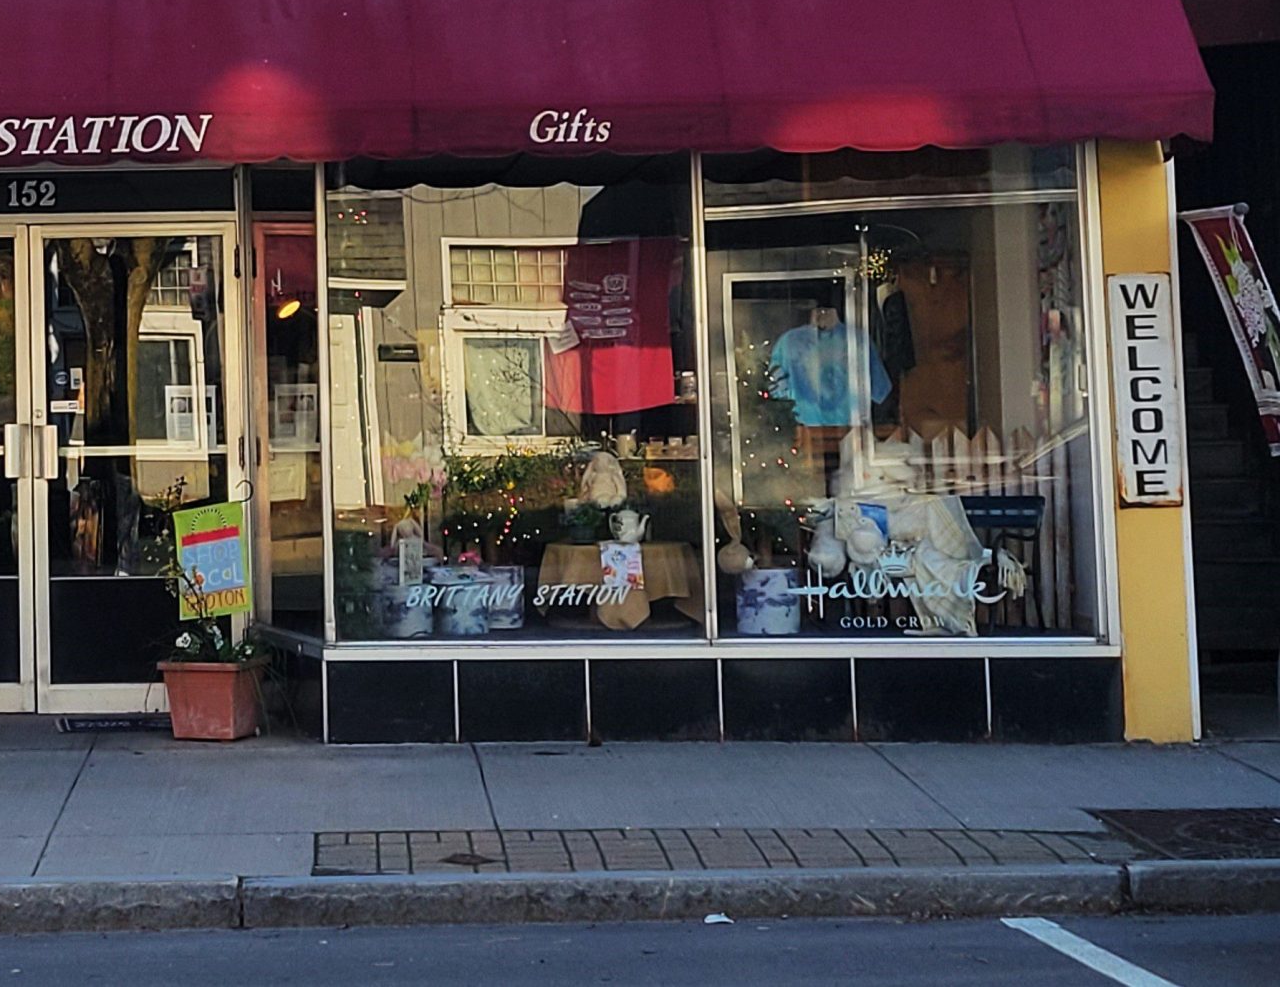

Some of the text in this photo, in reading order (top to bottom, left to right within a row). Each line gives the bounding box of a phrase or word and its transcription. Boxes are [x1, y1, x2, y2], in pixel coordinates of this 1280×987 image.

[529, 108, 611, 143] Gifts
[8, 180, 56, 207] 152
[1119, 283, 1169, 497] WELCOME
[406, 582, 633, 608] BRITTANY STATION
[786, 562, 1007, 619] Hallmark
[840, 615, 950, 628] GOLD CROW
